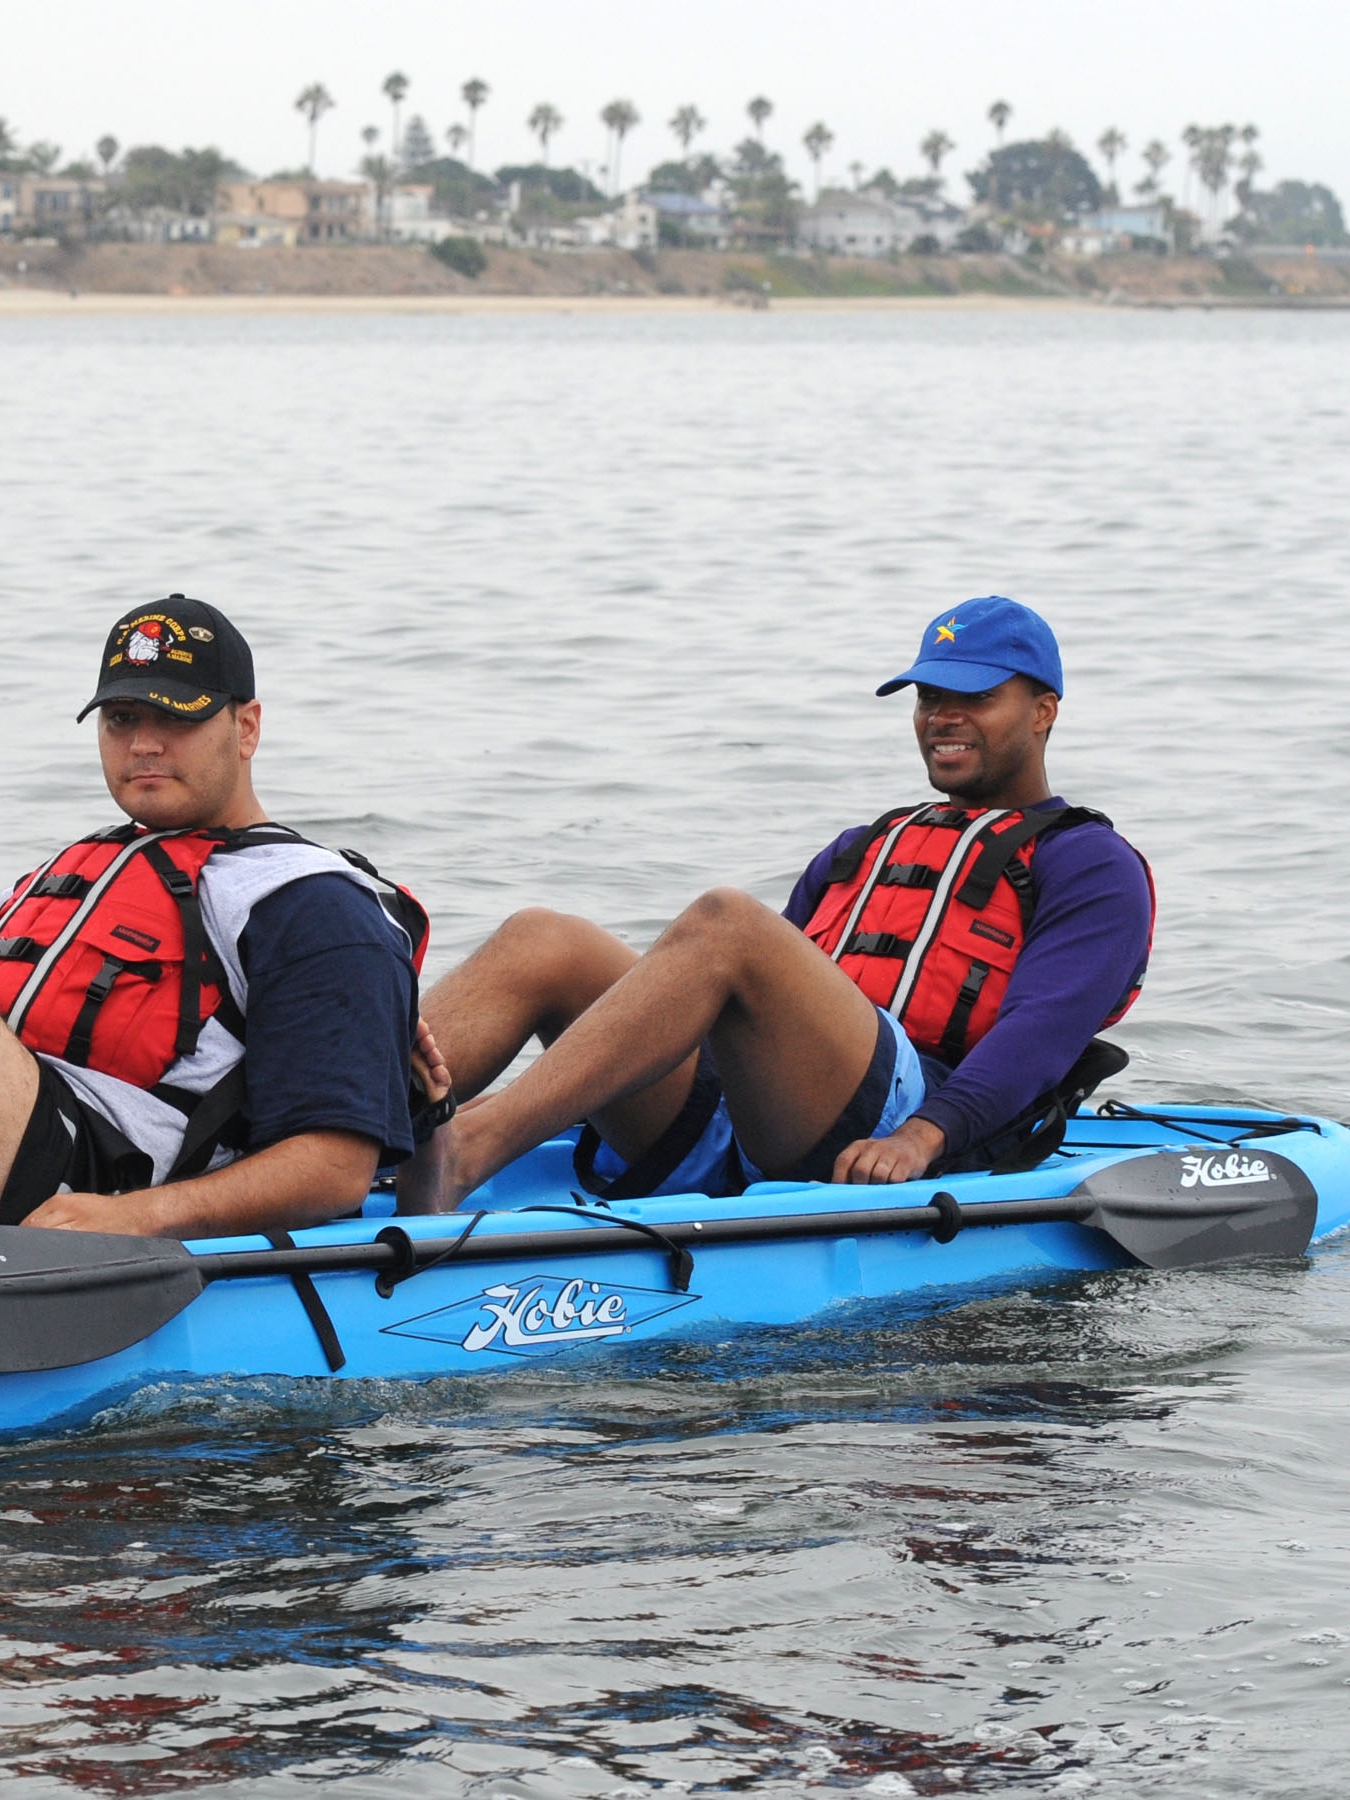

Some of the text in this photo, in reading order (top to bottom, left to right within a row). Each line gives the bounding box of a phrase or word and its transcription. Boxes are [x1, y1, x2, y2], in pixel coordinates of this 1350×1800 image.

[165, 617, 187, 642] CORPS
[1180, 1153, 1270, 1188] Hobie
[462, 1278, 628, 1352] Hobie
